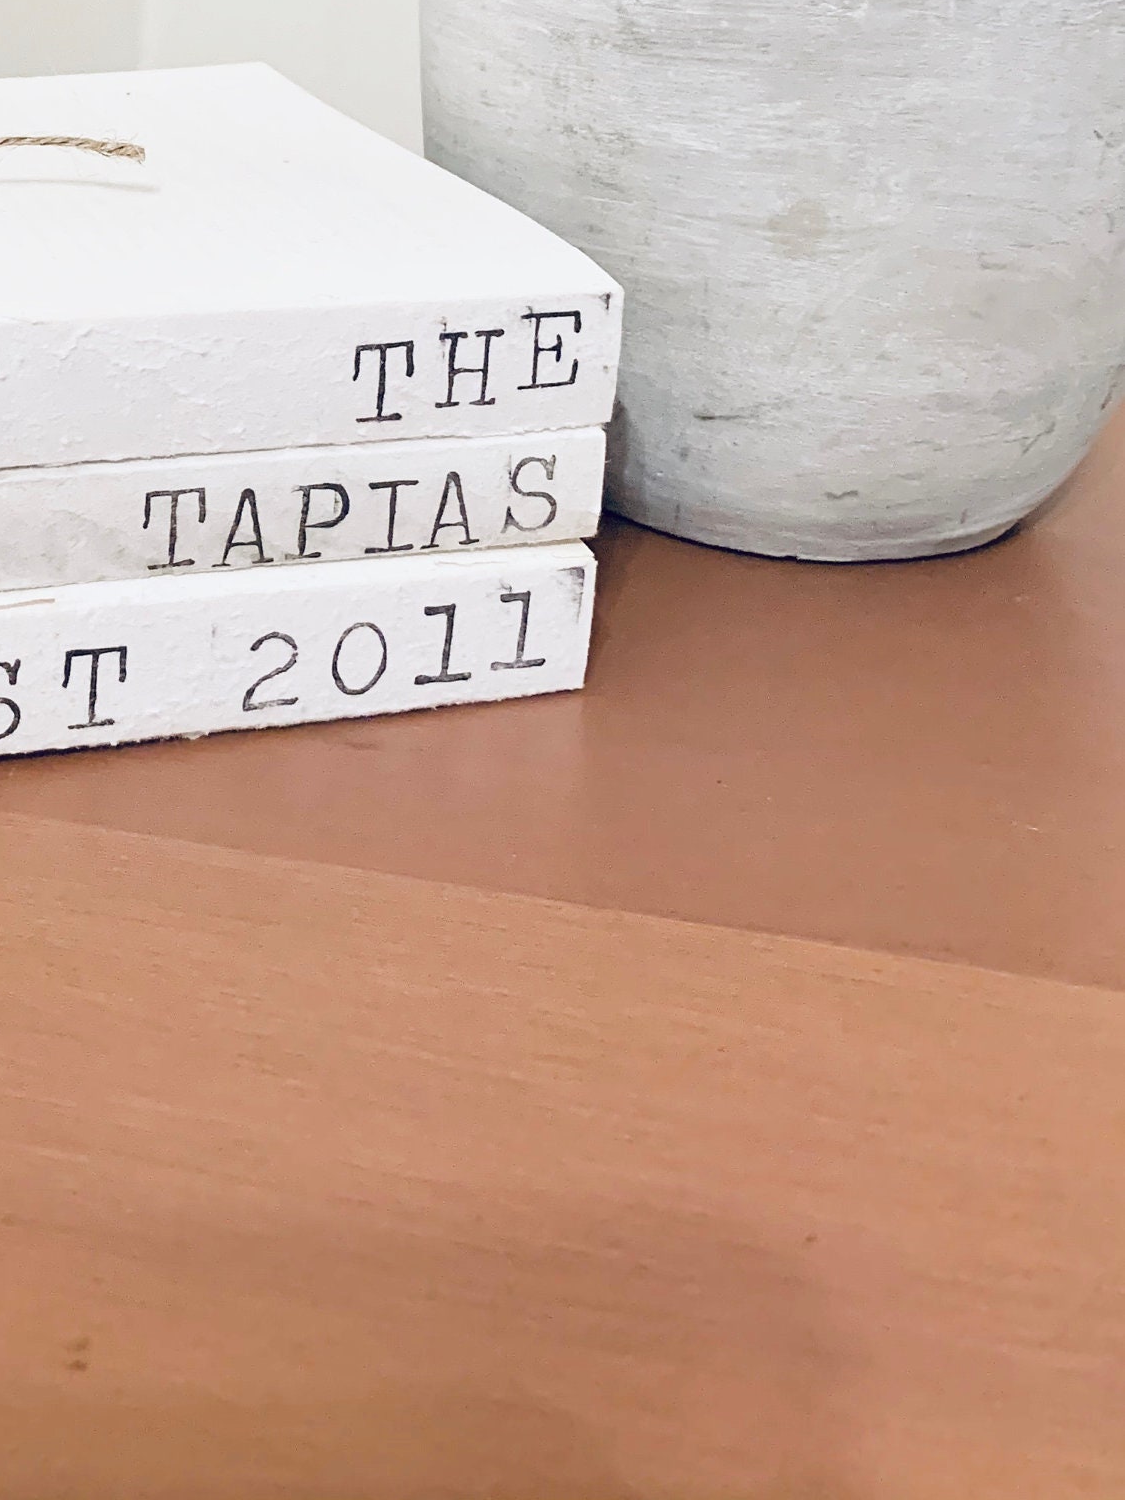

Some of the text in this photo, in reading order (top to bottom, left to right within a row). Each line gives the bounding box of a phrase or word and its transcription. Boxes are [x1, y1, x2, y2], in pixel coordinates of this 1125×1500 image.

[353, 310, 582, 422] THE
[142, 455, 559, 570] TAPIAS
[242, 590, 546, 712] 2011
